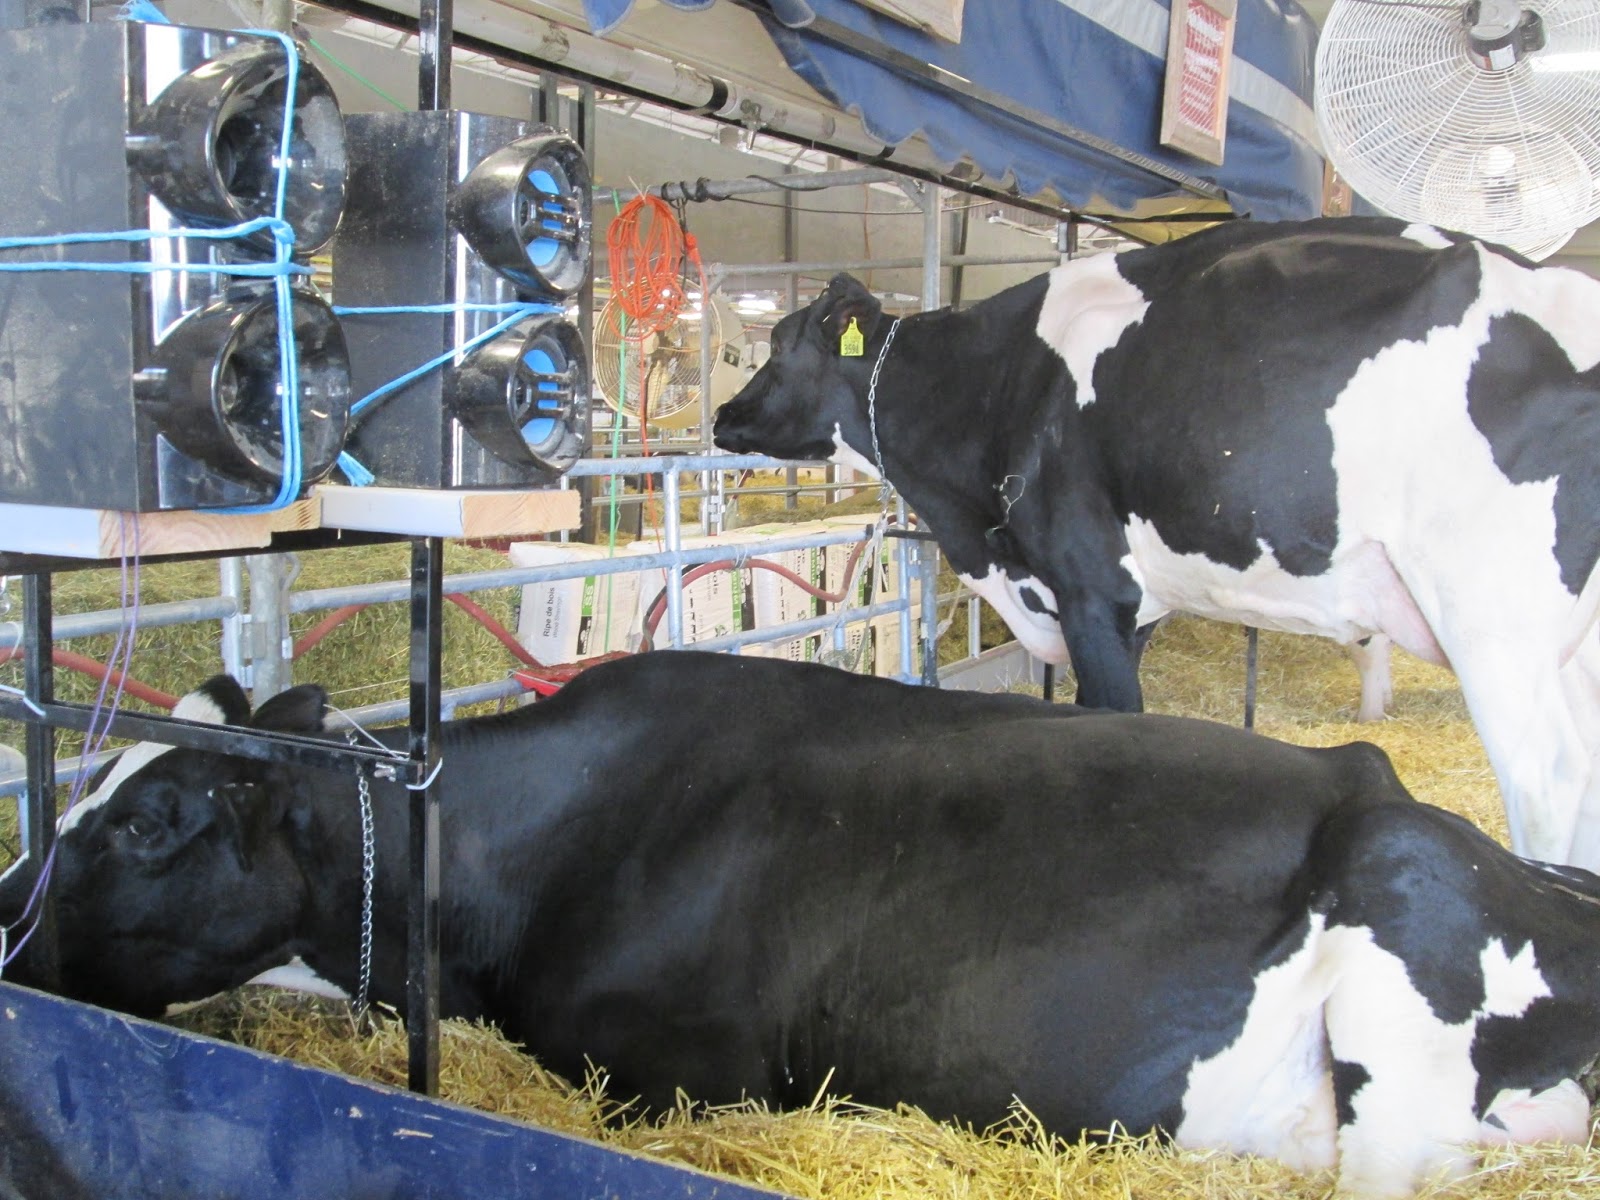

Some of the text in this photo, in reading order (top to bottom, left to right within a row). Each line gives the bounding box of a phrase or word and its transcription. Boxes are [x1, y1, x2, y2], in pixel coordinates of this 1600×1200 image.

[543, 587, 555, 637] Ripe de bois
